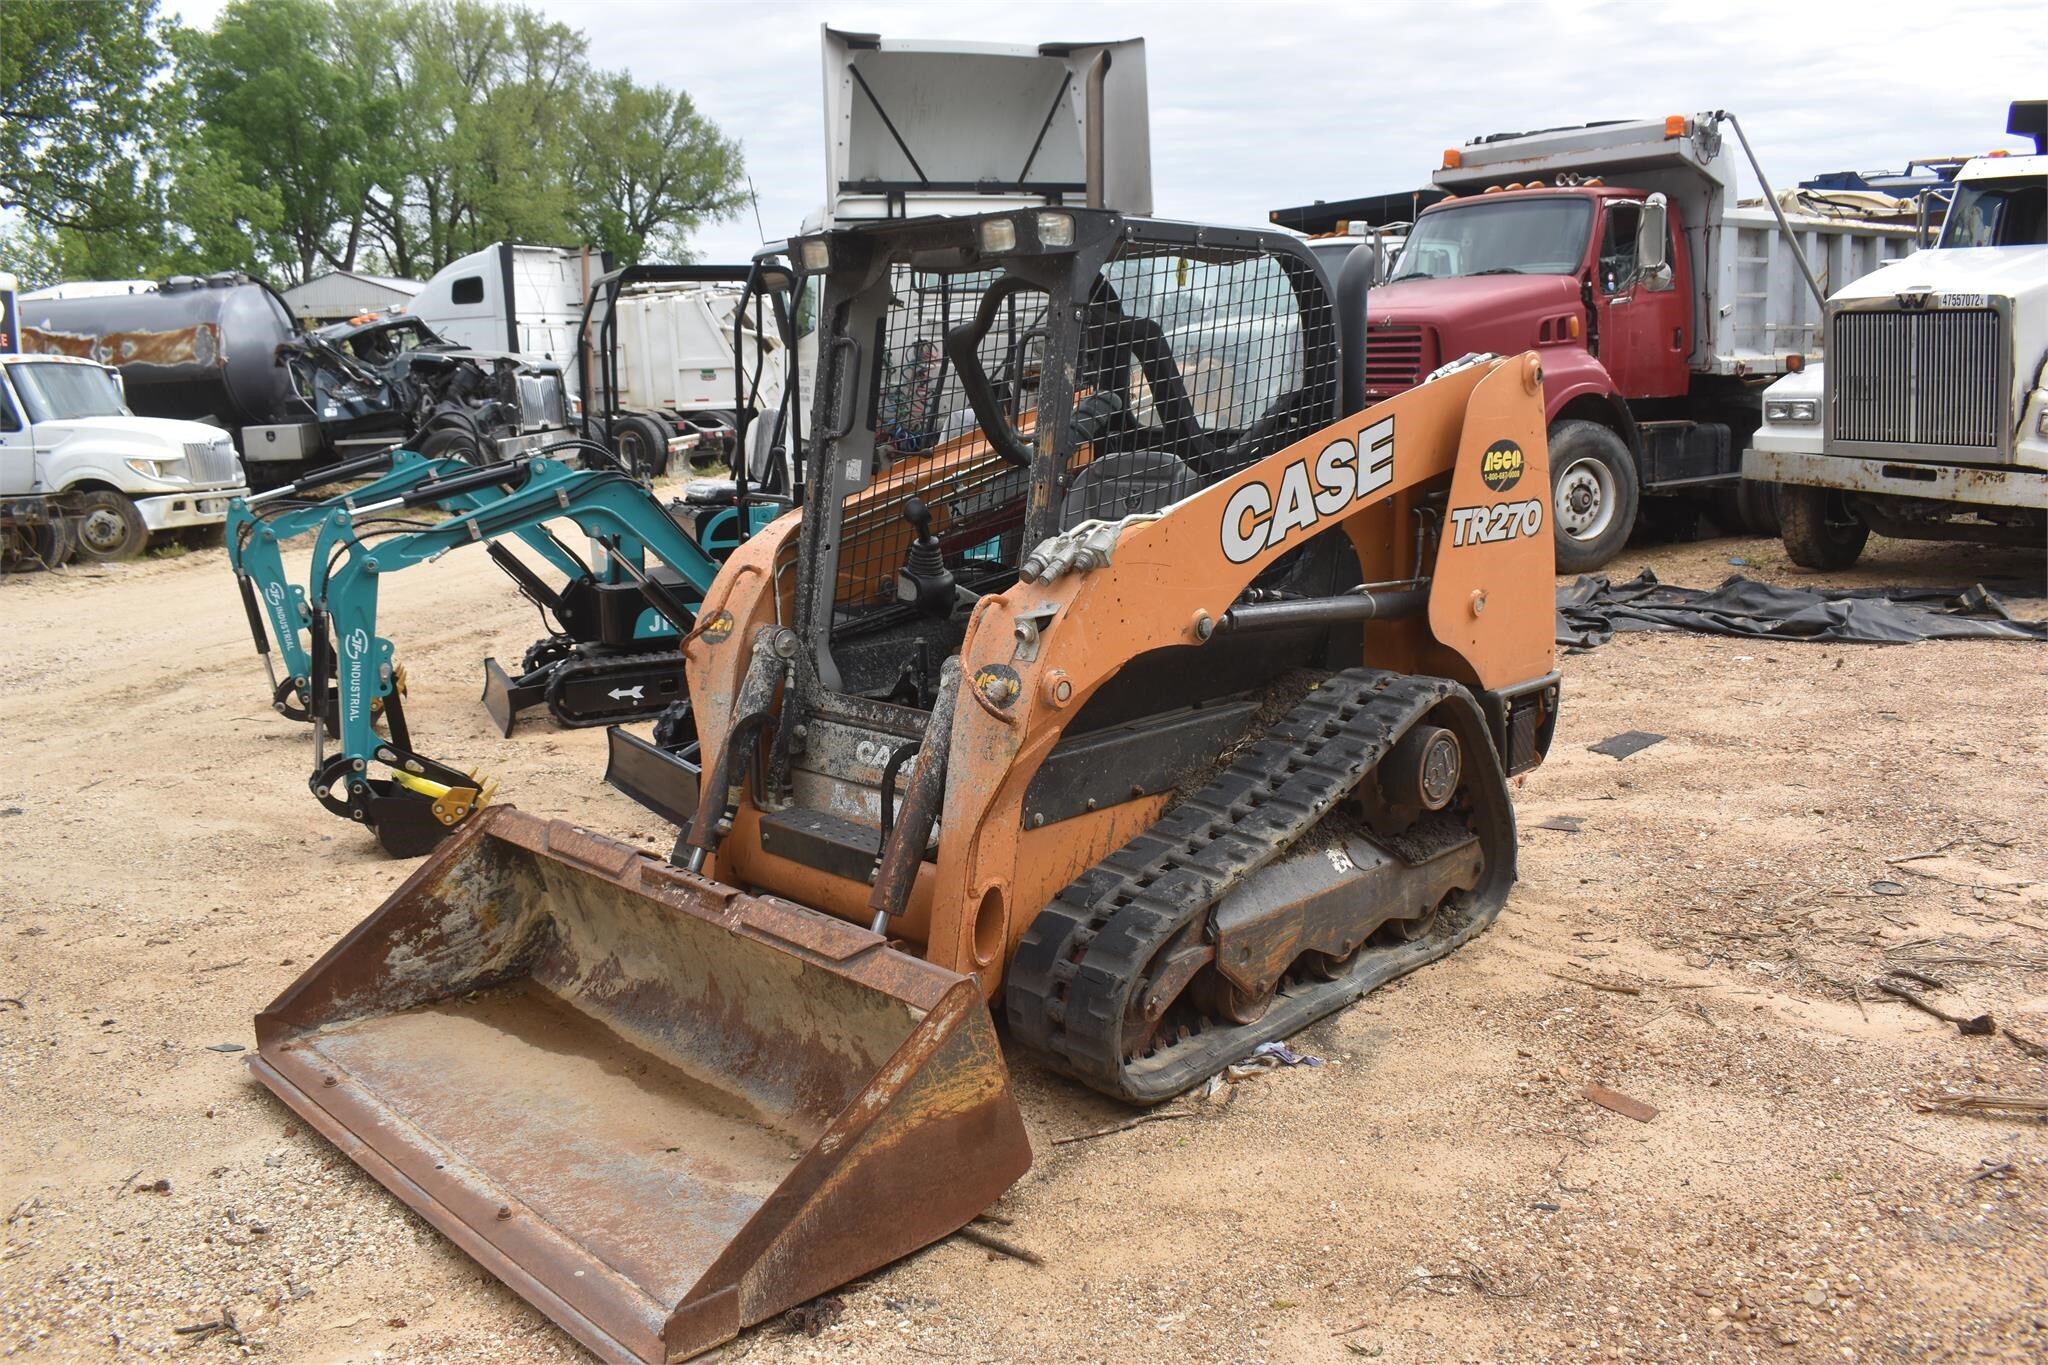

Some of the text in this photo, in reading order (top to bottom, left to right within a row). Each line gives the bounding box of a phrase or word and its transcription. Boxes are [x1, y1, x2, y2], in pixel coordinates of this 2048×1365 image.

[1483, 450, 1522, 472] ASCO
[1220, 414, 1395, 564] CASE
[1451, 498, 1543, 548] TR270
[275, 605, 295, 651] INDUSTRIAL
[349, 661, 361, 722] INDUSTRIAL
